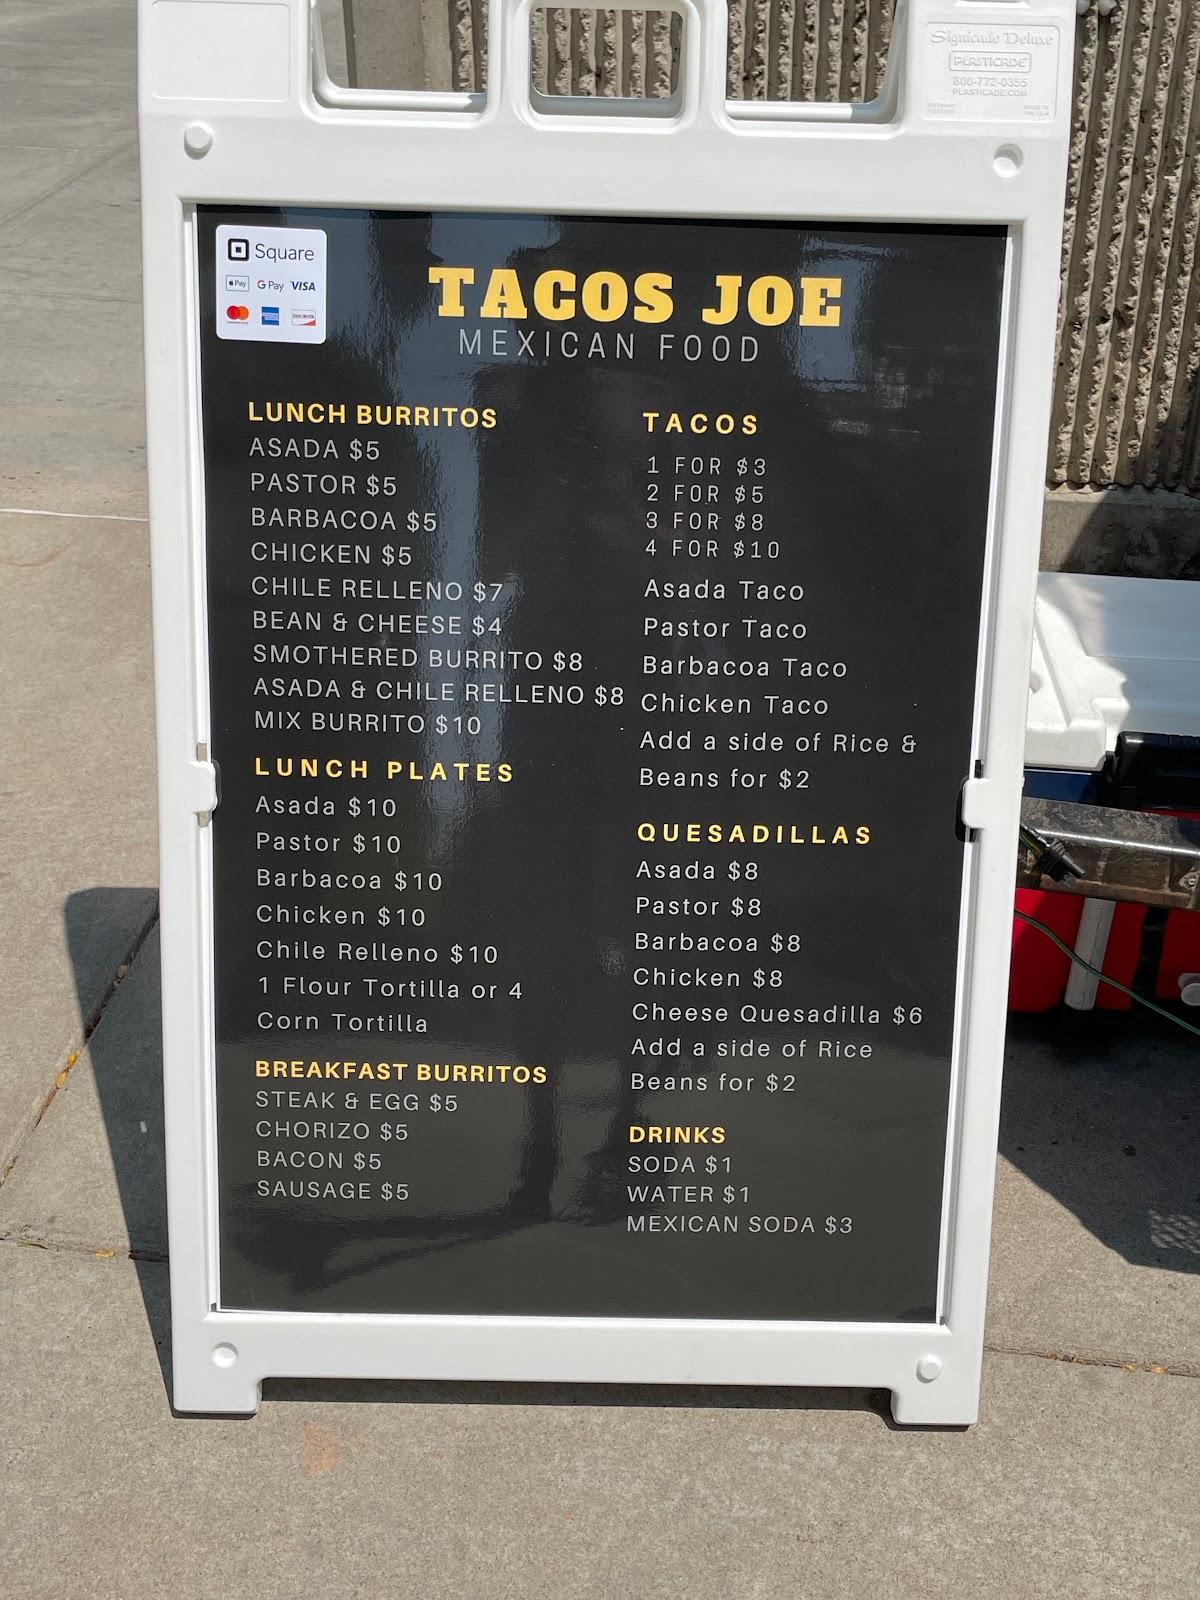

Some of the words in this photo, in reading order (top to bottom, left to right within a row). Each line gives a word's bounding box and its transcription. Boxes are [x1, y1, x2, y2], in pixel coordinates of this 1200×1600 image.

[255, 243, 315, 264] Square
[234, 279, 247, 288] Pay
[290, 280, 316, 291] VISA
[429, 267, 673, 323] TACOS
[702, 275, 841, 326] JOE
[460, 329, 633, 359] MEXICAN
[660, 334, 758, 361] FOOD
[249, 402, 345, 423] LUNCH
[357, 405, 496, 428] BURRITOS
[643, 413, 756, 434] TACOS
[250, 438, 338, 458] ASADA
[350, 439, 379, 461] $5
[648, 456, 658, 473] 1
[676, 457, 720, 474] FOR
[737, 457, 765, 476] $3
[252, 473, 355, 494] PASTOR
[367, 474, 396, 497] $5
[647, 484, 658, 501] 2
[675, 485, 718, 502] FOR
[735, 485, 763, 504] $5
[252, 508, 396, 530] BARBACOA
[407, 510, 436, 533] $5
[646, 512, 657, 528] 3
[674, 512, 718, 529] FOR
[735, 513, 763, 531] $8
[251, 542, 369, 564] CHICKEN
[382, 544, 411, 566] $5
[645, 539, 656, 555] 4
[673, 540, 718, 557] FOR
[734, 540, 779, 558] $10
[252, 577, 331, 596] CHILE
[343, 579, 462, 600] RELLENO
[474, 581, 502, 603] $7
[644, 579, 724, 599] Asada
[739, 581, 803, 600] Taco
[254, 611, 320, 630] BEAN
[333, 613, 347, 631] &
[358, 614, 461, 634] CHEESE
[473, 615, 502, 637] $4
[645, 618, 729, 637] Pastor
[742, 620, 806, 638] Taco
[254, 644, 417, 666] SMOTHERED
[430, 650, 542, 670] BURRITO
[553, 651, 582, 672] $8
[644, 656, 768, 676] Barbacoa
[783, 659, 846, 677] Taco
[254, 678, 340, 697] ASADA
[351, 681, 366, 698] &
[377, 681, 454, 700] CHILE
[466, 684, 583, 704] RELLENO
[595, 685, 623, 706] $8
[642, 693, 750, 713] Chicken
[765, 696, 828, 714] Taco
[256, 711, 301, 729] MIX
[313, 713, 424, 733] BURRITO
[436, 714, 480, 735] $10
[640, 731, 690, 749] Add
[704, 736, 715, 750] a
[729, 732, 783, 751] side
[796, 733, 821, 751] of
[834, 734, 888, 752] Rice
[902, 735, 916, 753] &
[256, 758, 367, 778] LUNCH
[388, 762, 512, 782] PLATES
[640, 768, 718, 787] Beans
[731, 769, 766, 787] for
[779, 769, 809, 790] $2
[256, 796, 334, 815] Asada
[349, 796, 396, 817] $10
[257, 832, 340, 851] Pastor
[353, 833, 400, 854] $10
[638, 823, 869, 844] QUESADILLAS
[258, 869, 380, 889] Barbacoa
[395, 871, 441, 891] $10
[636, 861, 714, 879] Asada
[728, 861, 757, 881] $8
[257, 905, 364, 924] Chicken
[378, 906, 424, 927] $10
[637, 897, 719, 915] Pastor
[731, 897, 760, 917] $8
[257, 940, 325, 959] Chile
[339, 943, 437, 962] Relleno
[451, 944, 497, 964] $10
[636, 933, 757, 951] Barbacoa
[771, 933, 800, 953] $8
[259, 977, 267, 993] 1
[284, 977, 351, 995] Flour
[363, 979, 458, 998] Tortilla
[472, 985, 497, 998] or
[509, 983, 522, 999] 4
[634, 968, 739, 986] Chicken
[753, 968, 782, 988] $8
[258, 1012, 318, 1029] Corn
[332, 1014, 426, 1032] Tortilla
[633, 1003, 727, 1021] Cheese
[741, 1005, 879, 1023] Quesadilla
[893, 1005, 922, 1025] $6
[631, 1038, 680, 1055] Add
[693, 1043, 704, 1056] a
[717, 1039, 770, 1056] side
[782, 1040, 806, 1057] of
[819, 1041, 872, 1058] Rice
[256, 1061, 408, 1080] BREAKFAST
[418, 1064, 546, 1083] BURRITOS
[632, 1073, 707, 1090] Beans
[719, 1073, 754, 1091] for
[766, 1073, 795, 1093] $2
[256, 1091, 334, 1108] STEAK
[345, 1093, 359, 1109] &
[370, 1094, 418, 1110] EGG
[430, 1093, 457, 1112] $5
[256, 1121, 369, 1139] CHORIZO
[380, 1122, 407, 1141] $5
[630, 1126, 725, 1143] DRINKS
[258, 1151, 342, 1168] BACON
[354, 1151, 381, 1171] $5
[628, 1156, 695, 1172] SODA
[705, 1155, 730, 1174] $1
[258, 1180, 370, 1199] SAUSAGE
[381, 1182, 408, 1201] $5
[627, 1186, 713, 1202] WATER
[723, 1185, 748, 1204] $1
[628, 1216, 737, 1232] MEXICAN
[749, 1216, 814, 1232] SODA
[825, 1216, 852, 1234] $3
